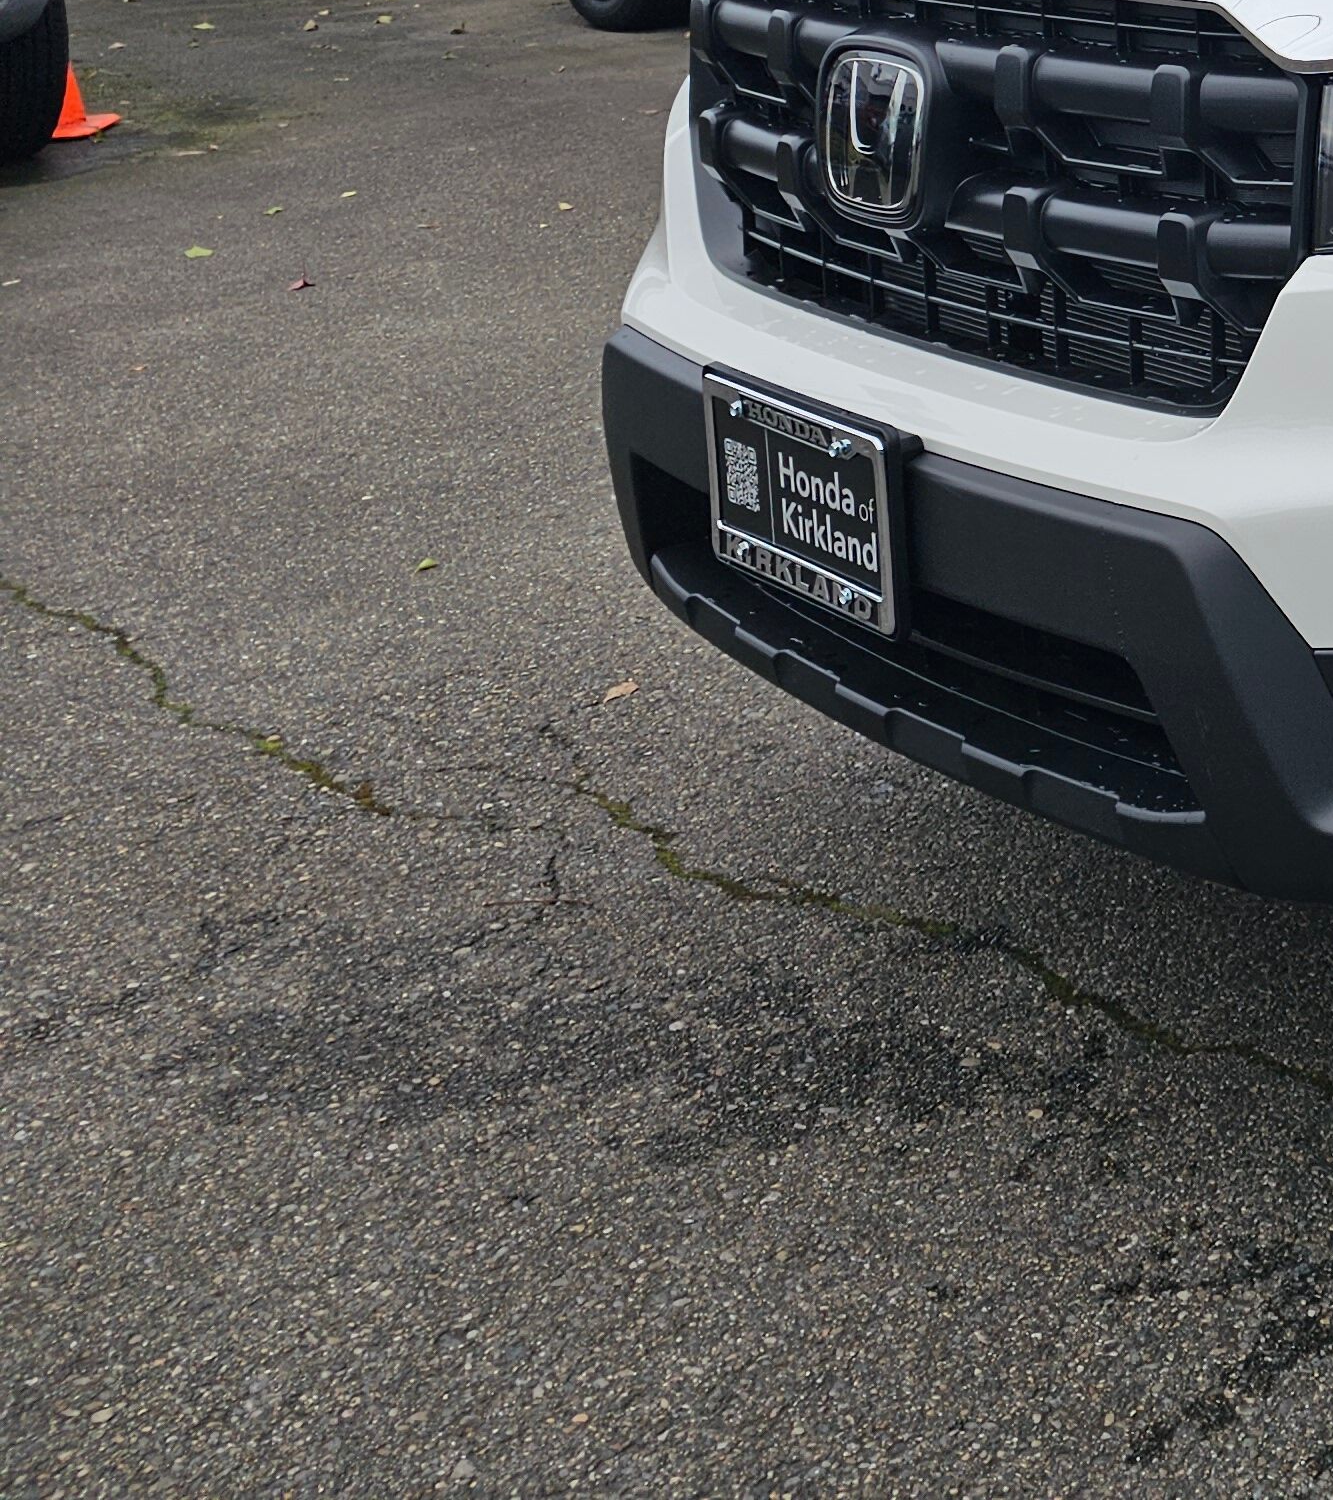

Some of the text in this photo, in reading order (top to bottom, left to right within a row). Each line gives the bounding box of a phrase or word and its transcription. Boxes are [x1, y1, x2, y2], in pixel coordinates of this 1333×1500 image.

[749, 400, 830, 448] HONDA
[778, 451, 875, 524] Honda of
[781, 497, 878, 573] Kirkland
